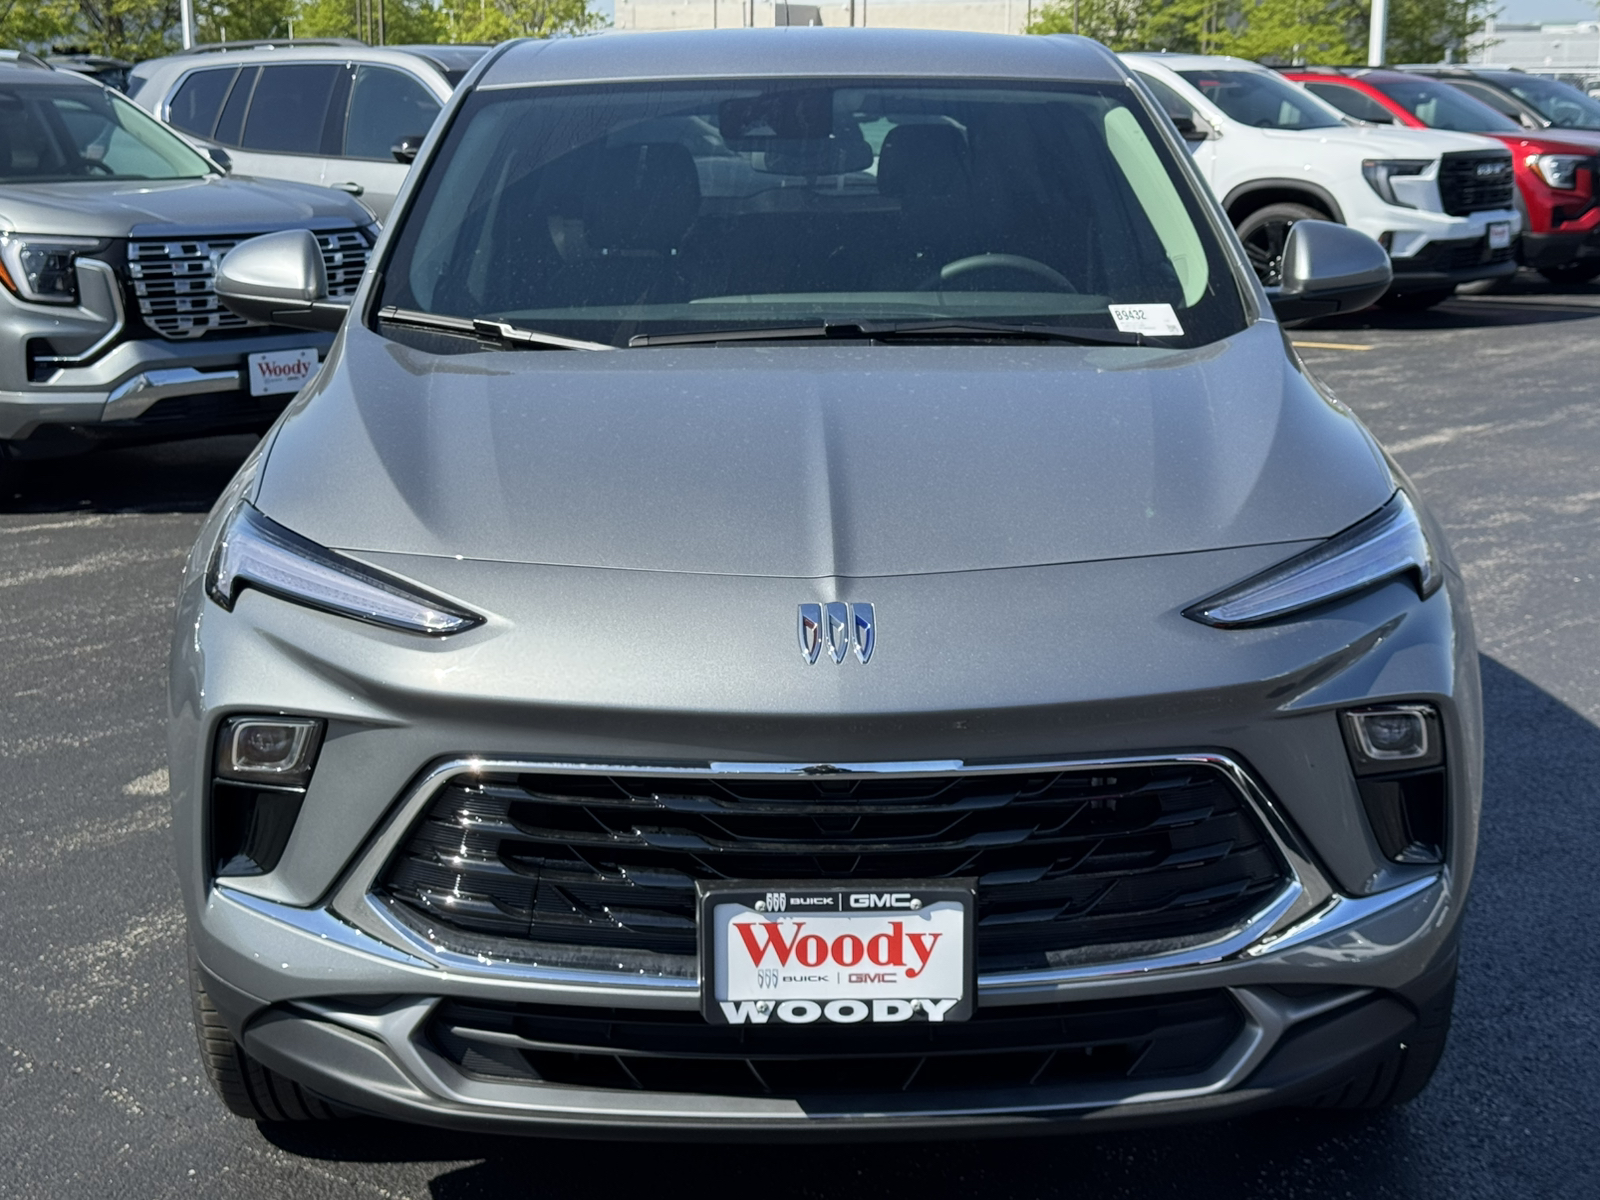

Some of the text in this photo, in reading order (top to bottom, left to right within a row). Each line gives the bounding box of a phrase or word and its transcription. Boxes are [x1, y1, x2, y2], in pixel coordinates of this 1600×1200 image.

[257, 359, 311, 378] Woody
[789, 893, 912, 908] BUICK GMC
[732, 921, 943, 979] Woody
[782, 972, 898, 984] BUICK GMC
[719, 999, 959, 1025] WOODY
